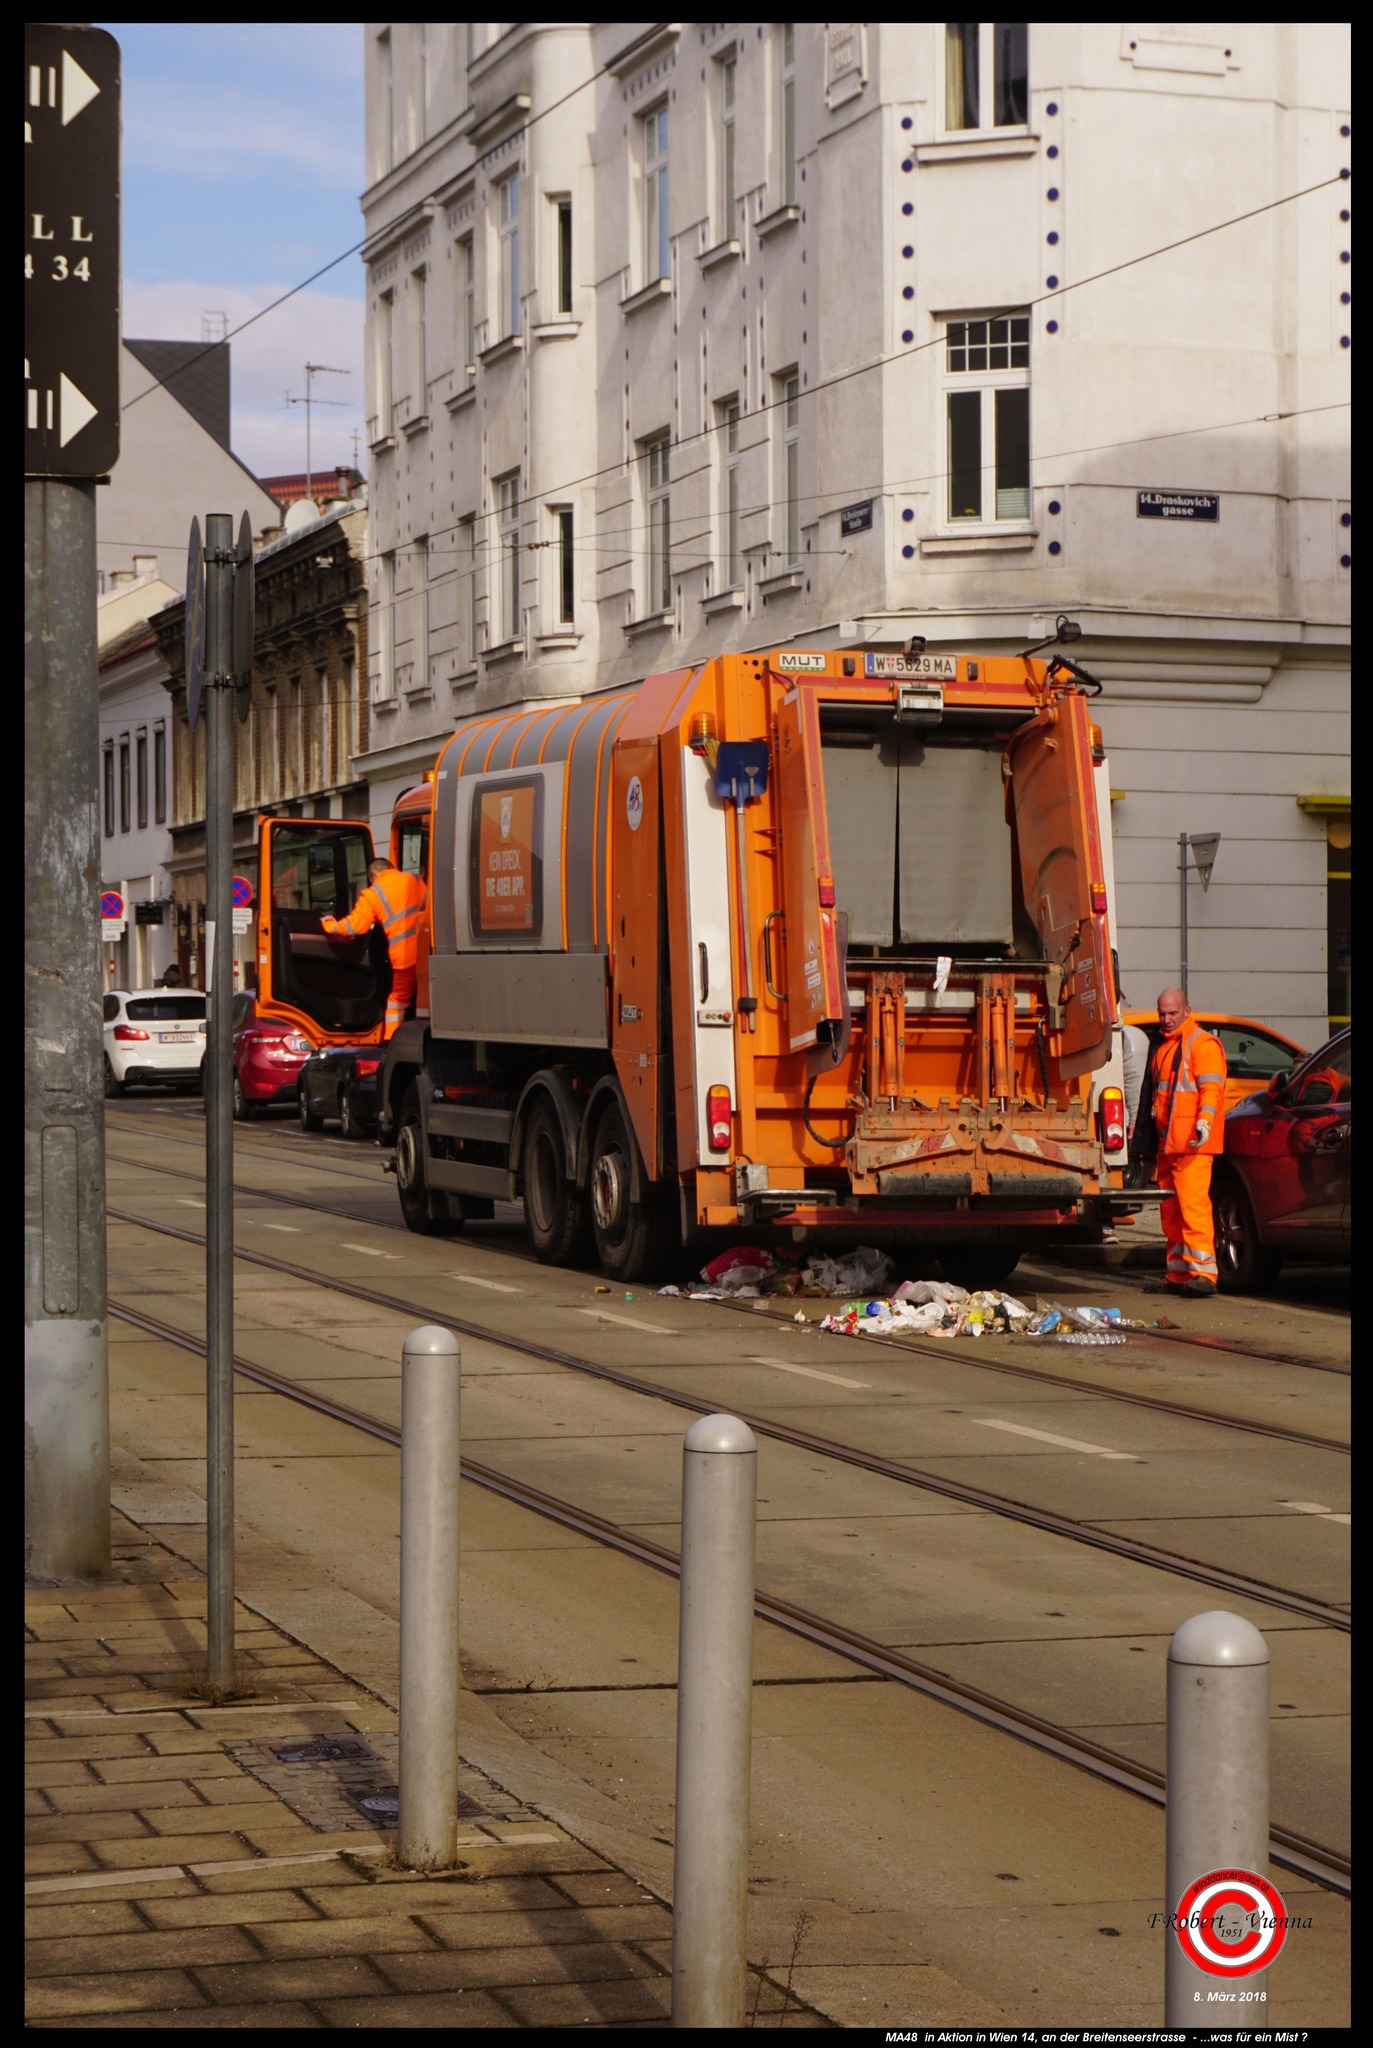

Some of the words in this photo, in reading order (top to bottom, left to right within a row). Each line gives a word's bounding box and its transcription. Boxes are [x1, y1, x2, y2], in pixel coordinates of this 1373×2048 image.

[51, 255, 91, 282] 34
[1162, 506, 1194, 517] gasse
[782, 655, 823, 667] MUT
[896, 657, 930, 673] 5629
[934, 659, 953, 674] MA
